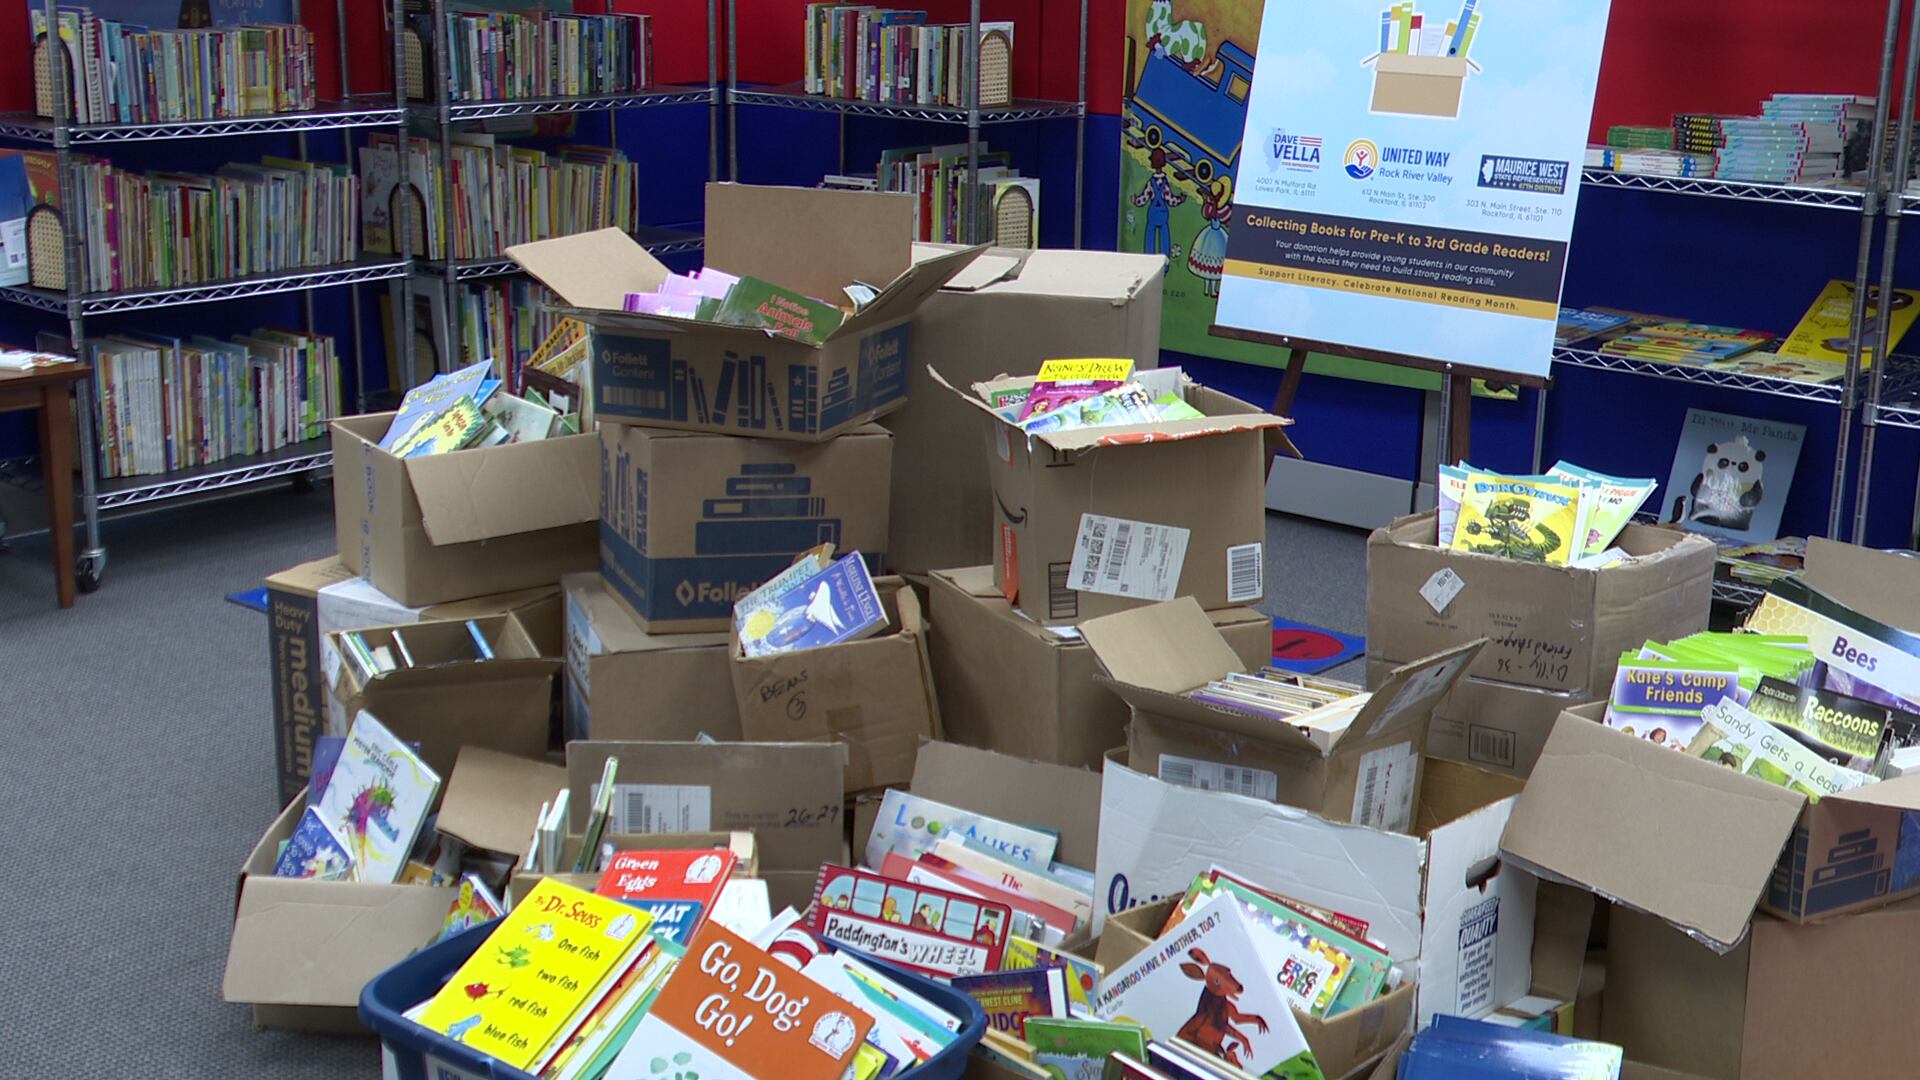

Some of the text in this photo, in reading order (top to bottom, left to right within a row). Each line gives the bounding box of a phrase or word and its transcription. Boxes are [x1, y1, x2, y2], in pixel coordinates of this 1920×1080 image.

[1274, 134, 1299, 144] DAVE
[1273, 144, 1320, 163] VELLA
[1382, 147, 1450, 167] UNITED WAY
[1380, 168, 1453, 186] Rock River Valley
[1495, 158, 1567, 178] MAURICE WEST
[1512, 175, 1563, 185] REPRESENTATIVE
[1534, 185, 1562, 193] DISTRICT
[1369, 197, 1400, 207] Rockford,
[1380, 190, 1396, 198] Main
[1482, 209, 1515, 219] Rockford,
[1491, 201, 1507, 210] Main
[1246, 215, 1551, 262] Collecting Books for Pre-K to 3rd Grade Readers!
[1275, 240, 1514, 279] Your donation helps provide young students in our community
[1284, 252, 1496, 286] with the books they need to build strong reading skills.
[1258, 267, 1519, 311] Support Literacy. Celebrate National Reading Month.
[757, 302, 813, 332] Animals
[611, 351, 649, 367] Follett
[1043, 361, 1127, 374] NANCY DREW
[612, 366, 655, 379] Content
[1762, 425, 1798, 441] Panda
[760, 563, 811, 598] TRUMPET
[274, 601, 311, 622] Heavy
[275, 615, 302, 633] Duty
[1831, 635, 1878, 672] Bees
[1498, 658, 1511, 674] 36
[1626, 669, 1727, 692] Kate's Camp
[1645, 687, 1704, 704] Friends
[290, 637, 316, 777] medium
[1802, 695, 1880, 737] Raccoons
[1716, 705, 1755, 739] Sandy
[1760, 735, 1791, 762] Gets
[1794, 761, 1804, 771] a
[614, 857, 660, 870] Green
[617, 874, 658, 892] Eggs
[1001, 872, 1024, 891] The
[535, 896, 602, 930] By Dr. Seuss
[827, 918, 908, 956] Paddington's
[910, 943, 976, 965] WHEEL
[1461, 914, 1498, 948] QUALITY
[558, 938, 601, 961] One fish
[1096, 911, 1221, 1008] A KANGAROO HAVE A MOTHER, TOO ?
[536, 969, 579, 993] two fish
[1282, 958, 1318, 985] ERIC
[700, 941, 810, 1032] Go, Dog.
[1277, 970, 1313, 999] CARLE
[508, 996, 549, 1018] red fish
[1003, 994, 1023, 1006] CLINE
[695, 993, 753, 1048] Go!
[484, 1024, 528, 1050] blue fish
